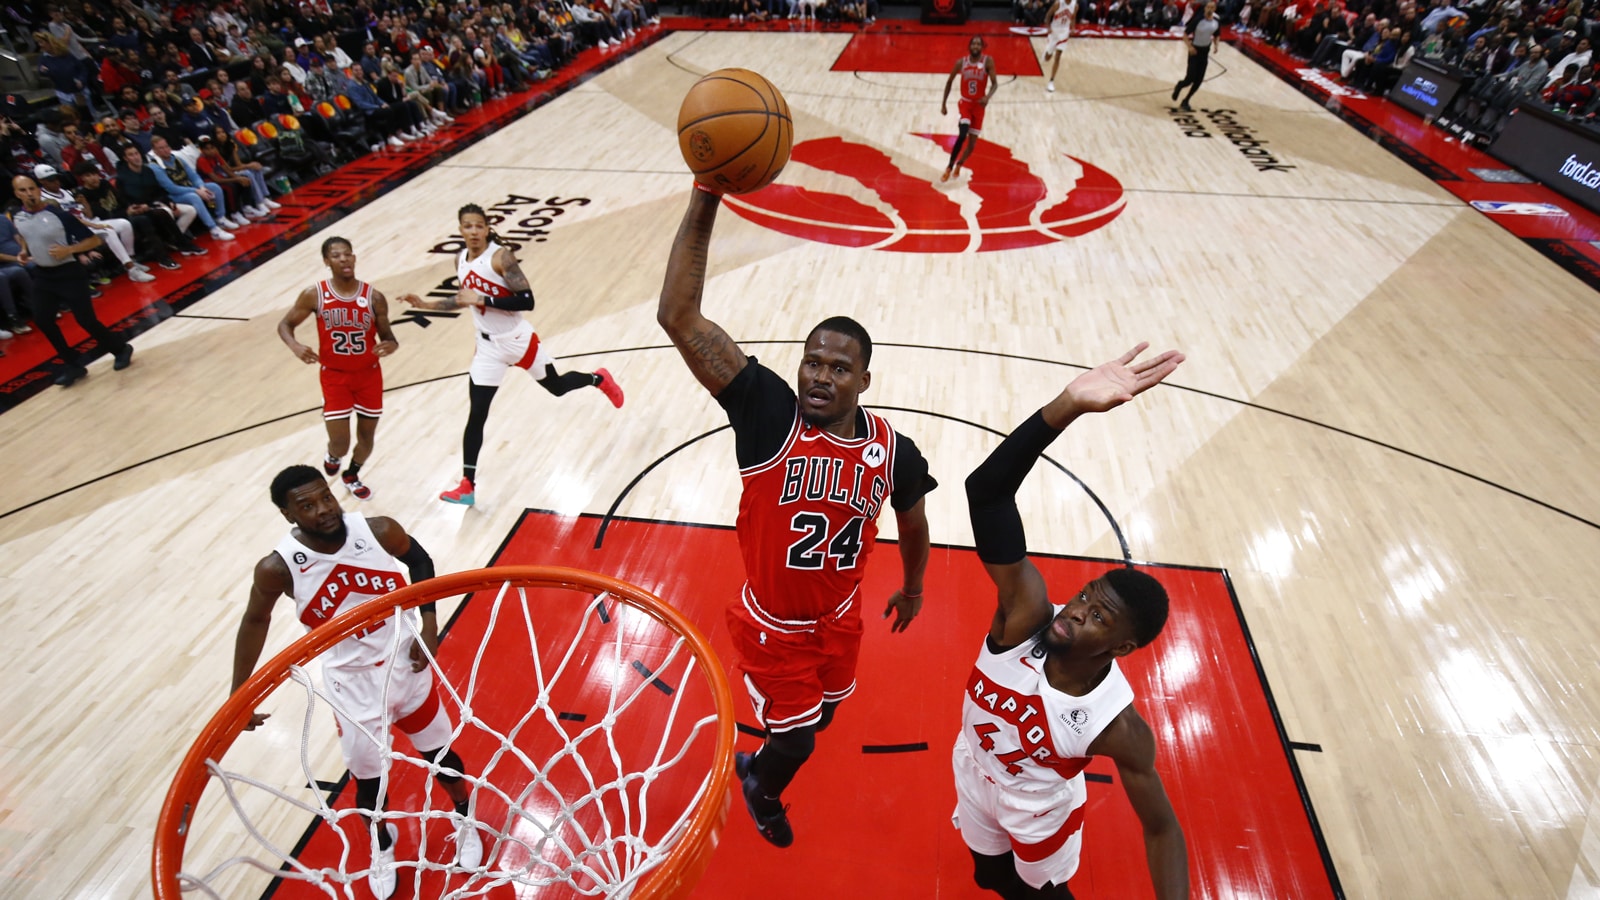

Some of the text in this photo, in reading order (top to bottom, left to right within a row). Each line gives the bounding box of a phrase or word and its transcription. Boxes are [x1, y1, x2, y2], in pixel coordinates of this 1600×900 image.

[968, 81, 977, 95] 5
[1200, 108, 1297, 173] Scotiabank
[427, 194, 541, 253] Area
[463, 274, 500, 296] PTORS
[322, 307, 371, 331] BULLS
[330, 330, 366, 355] 25
[778, 455, 886, 521] BULLS
[297, 553, 305, 564] 6
[785, 510, 865, 572] 24
[311, 571, 397, 619] RAPTORS
[974, 679, 1060, 764] RAPTOR
[1060, 713, 1083, 735] Sun Life
[973, 722, 1029, 777] 44
